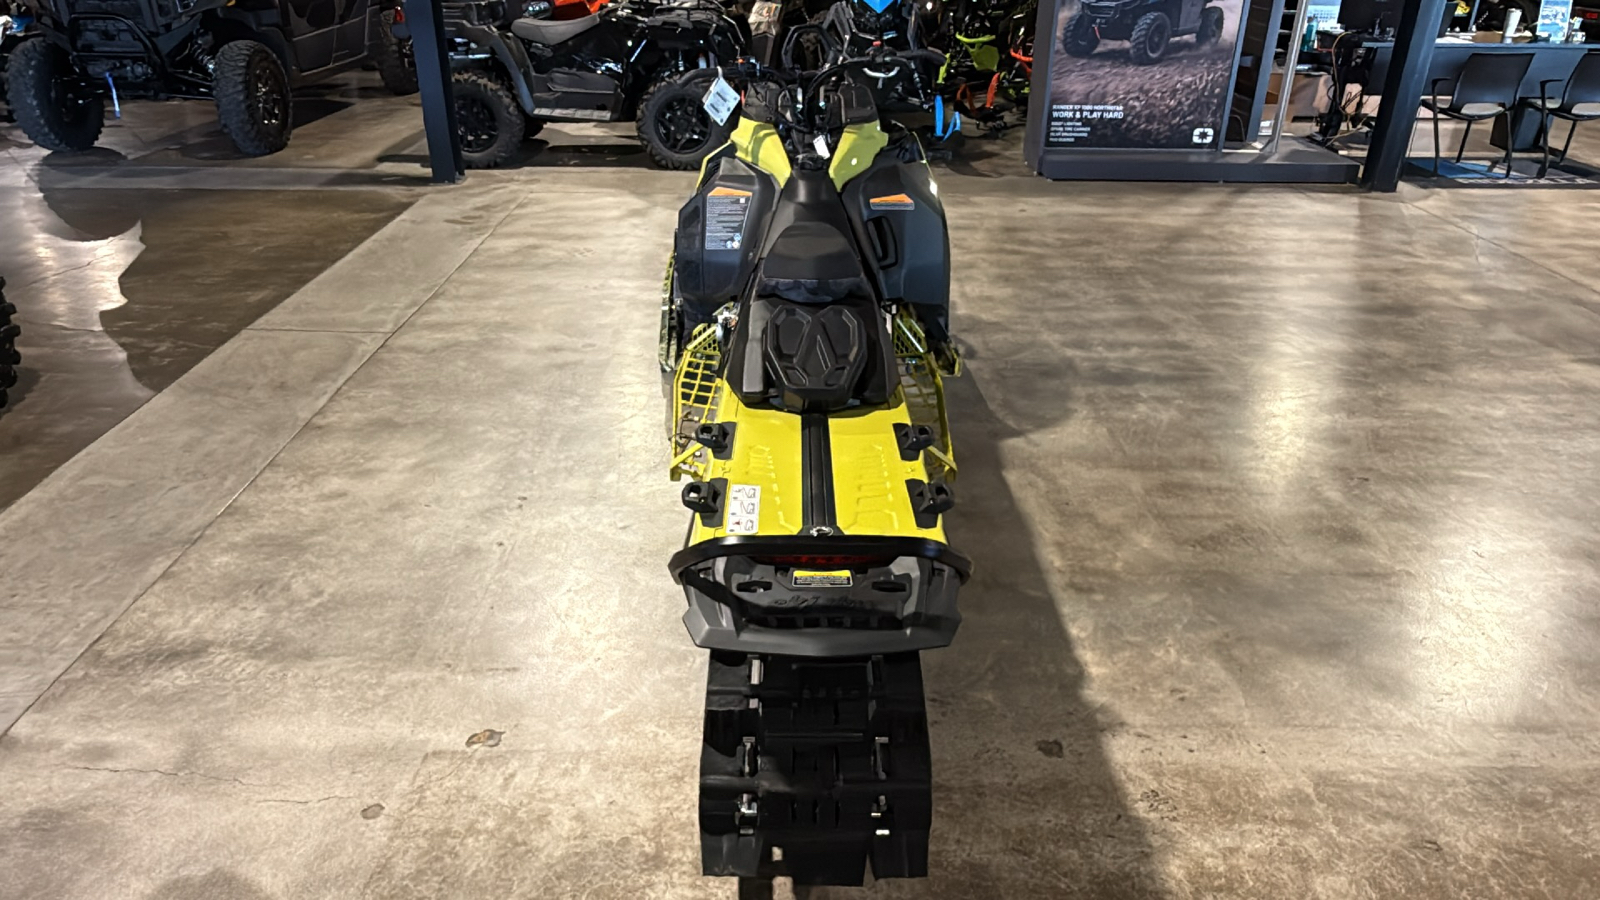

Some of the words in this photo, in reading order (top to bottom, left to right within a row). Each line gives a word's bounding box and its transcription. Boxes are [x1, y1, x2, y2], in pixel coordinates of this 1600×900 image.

[1075, 111, 1081, 119] &
[1082, 111, 1102, 119] PLAY
[1103, 111, 1124, 119] HARD
